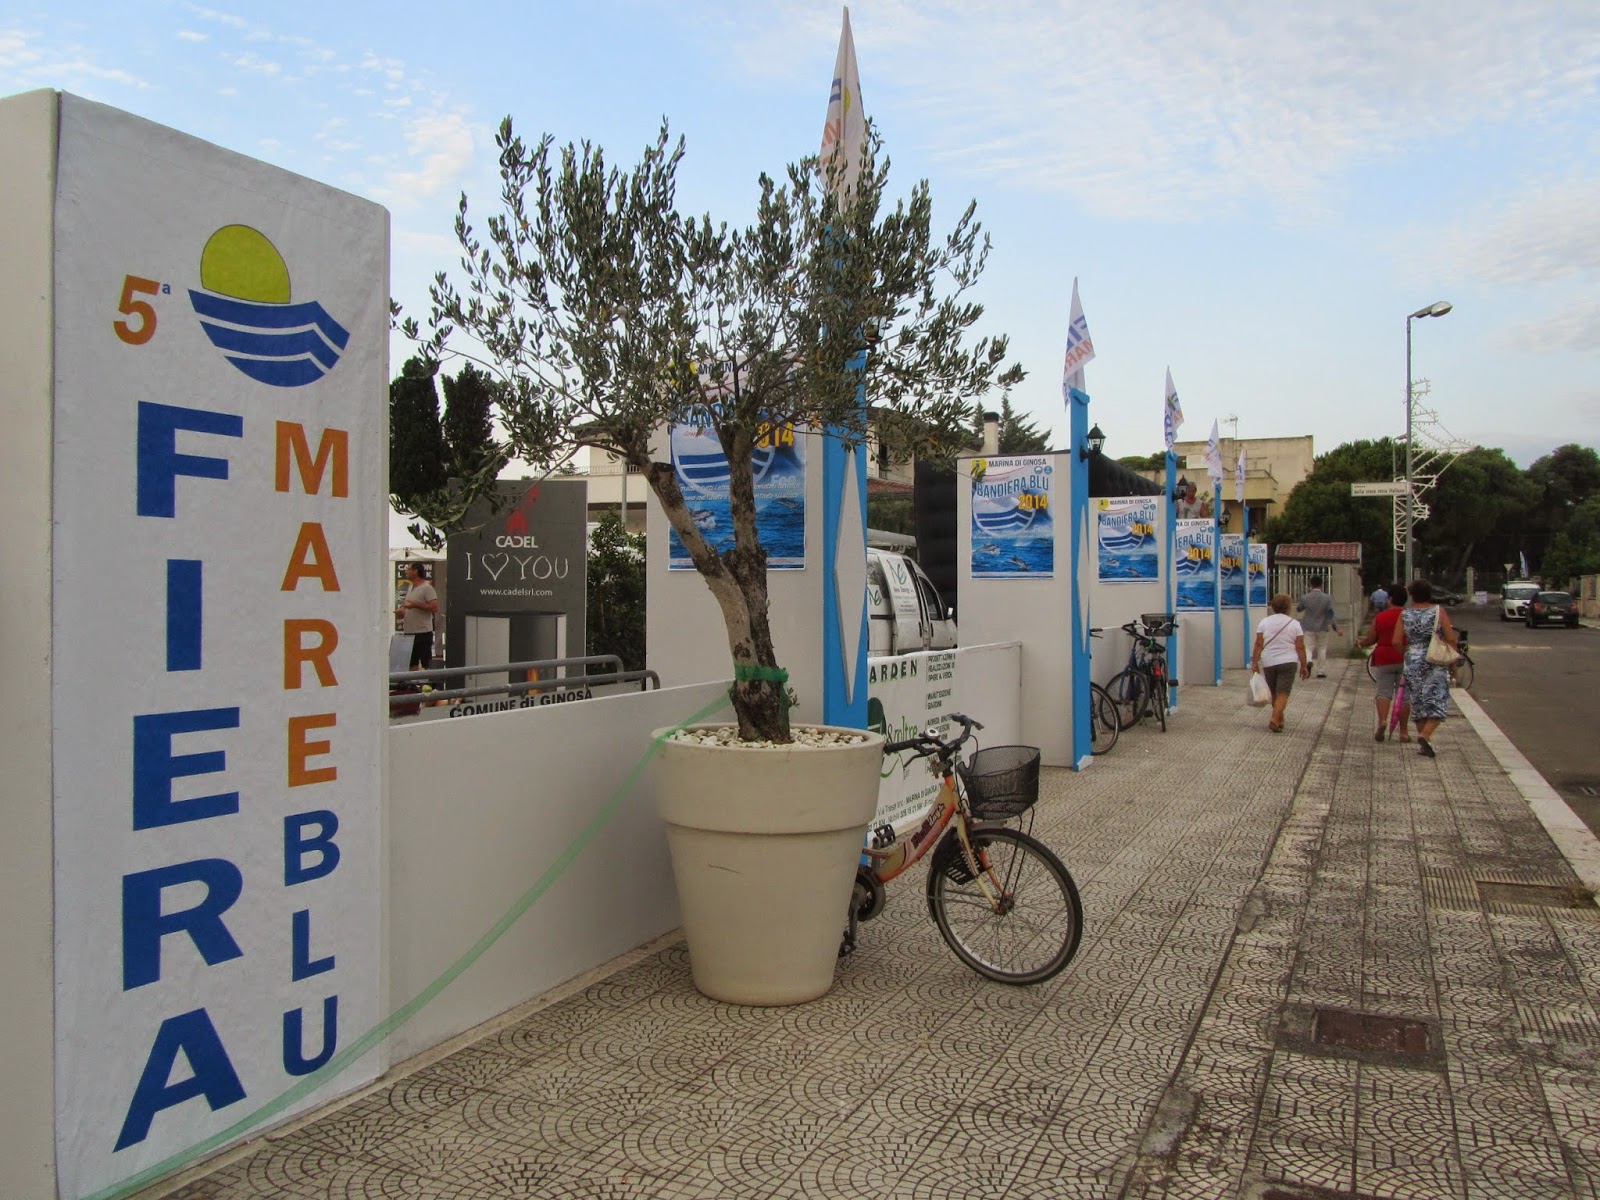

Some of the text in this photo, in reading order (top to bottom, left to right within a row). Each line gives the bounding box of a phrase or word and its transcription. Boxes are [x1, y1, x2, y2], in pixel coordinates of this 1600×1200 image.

[988, 460, 1014, 468] MARINA
[976, 475, 1049, 498] BANDIERA BLU
[1017, 493, 1048, 510] 2014
[1101, 510, 1154, 527] BANDIERA BLU
[1131, 523, 1153, 535] 2014
[495, 535, 539, 549] CADEL
[1196, 533, 1212, 546] BLU
[1187, 547, 1211, 560] 2014
[465, 552, 569, 581] I YOU
[480, 588, 553, 597] www.cadelsrl.com
[868, 660, 918, 684] ARDEN
[450, 689, 593, 719] COMUNE di GINOSA
[112, 400, 247, 1153] FIERA
